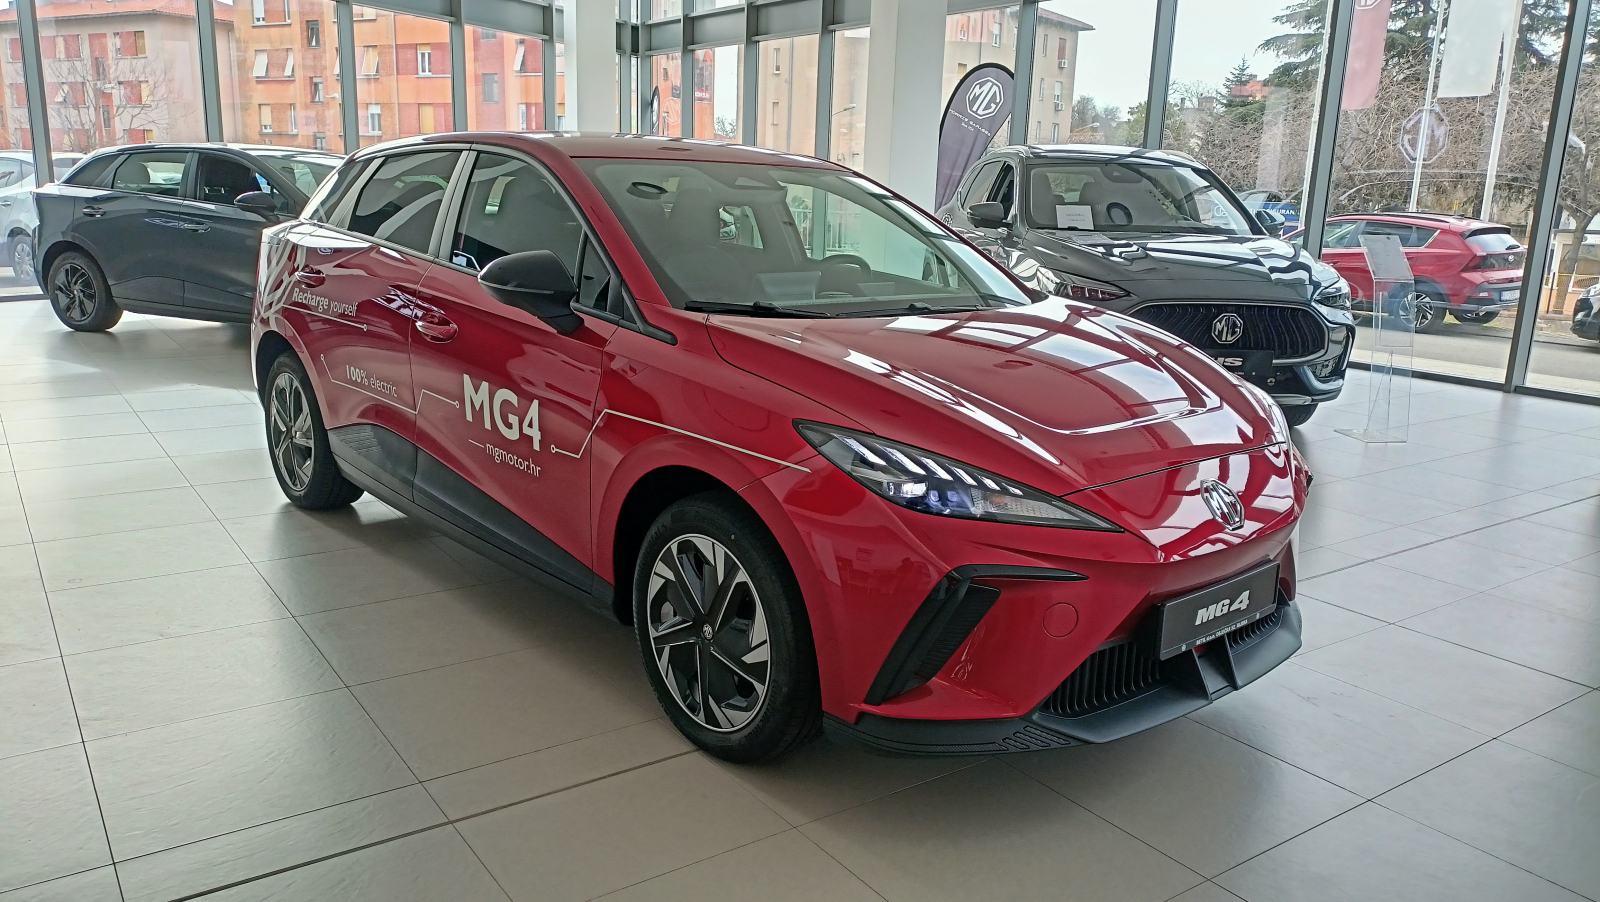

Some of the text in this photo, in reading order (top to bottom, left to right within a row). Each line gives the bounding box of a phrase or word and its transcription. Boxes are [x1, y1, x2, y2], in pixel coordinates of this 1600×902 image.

[969, 80, 1001, 115] MG
[292, 288, 359, 318] Recharge yourself
[1214, 315, 1242, 342] MG
[345, 364, 398, 398] 100% electric
[463, 374, 541, 452] MG4
[485, 442, 542, 478] mgmotor.hr
[1203, 481, 1242, 529] MG
